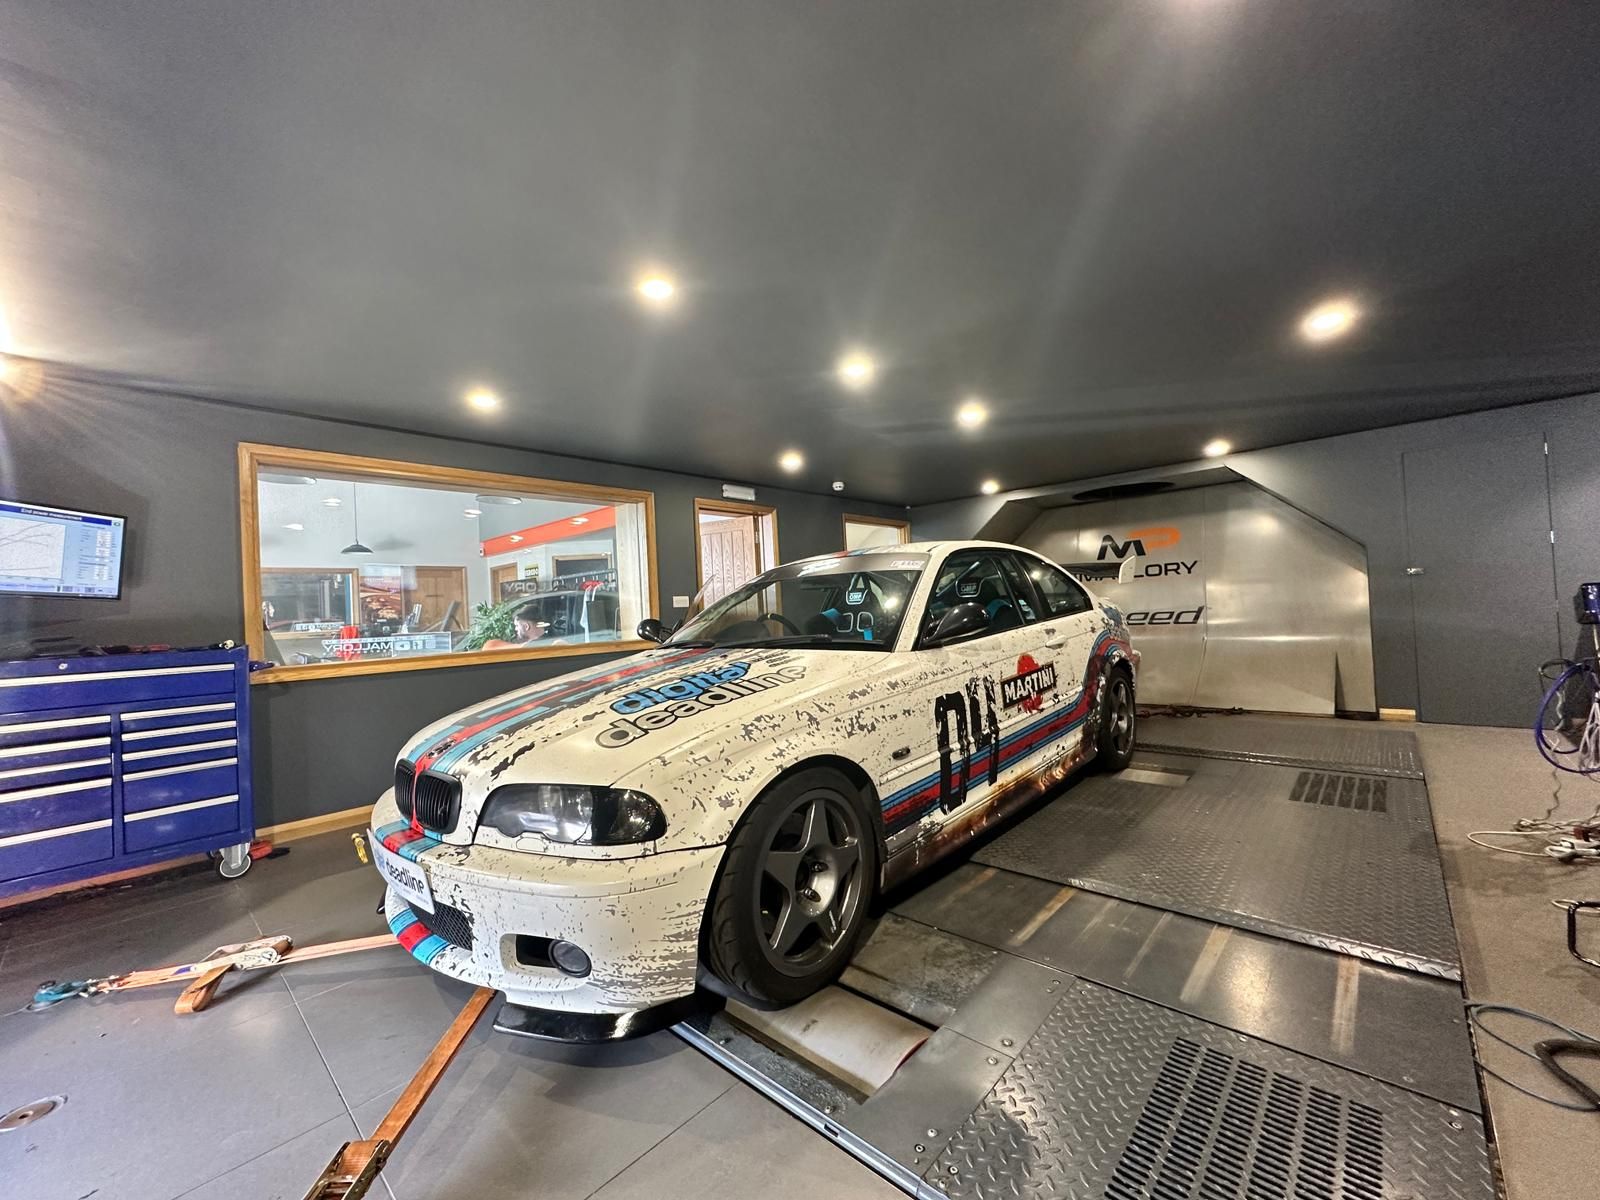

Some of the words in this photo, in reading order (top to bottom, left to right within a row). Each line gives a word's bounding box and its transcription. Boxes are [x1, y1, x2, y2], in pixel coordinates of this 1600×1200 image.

[595, 666, 807, 748] deadline
[610, 661, 752, 715] digital
[1004, 667, 1054, 703] MARTINI
